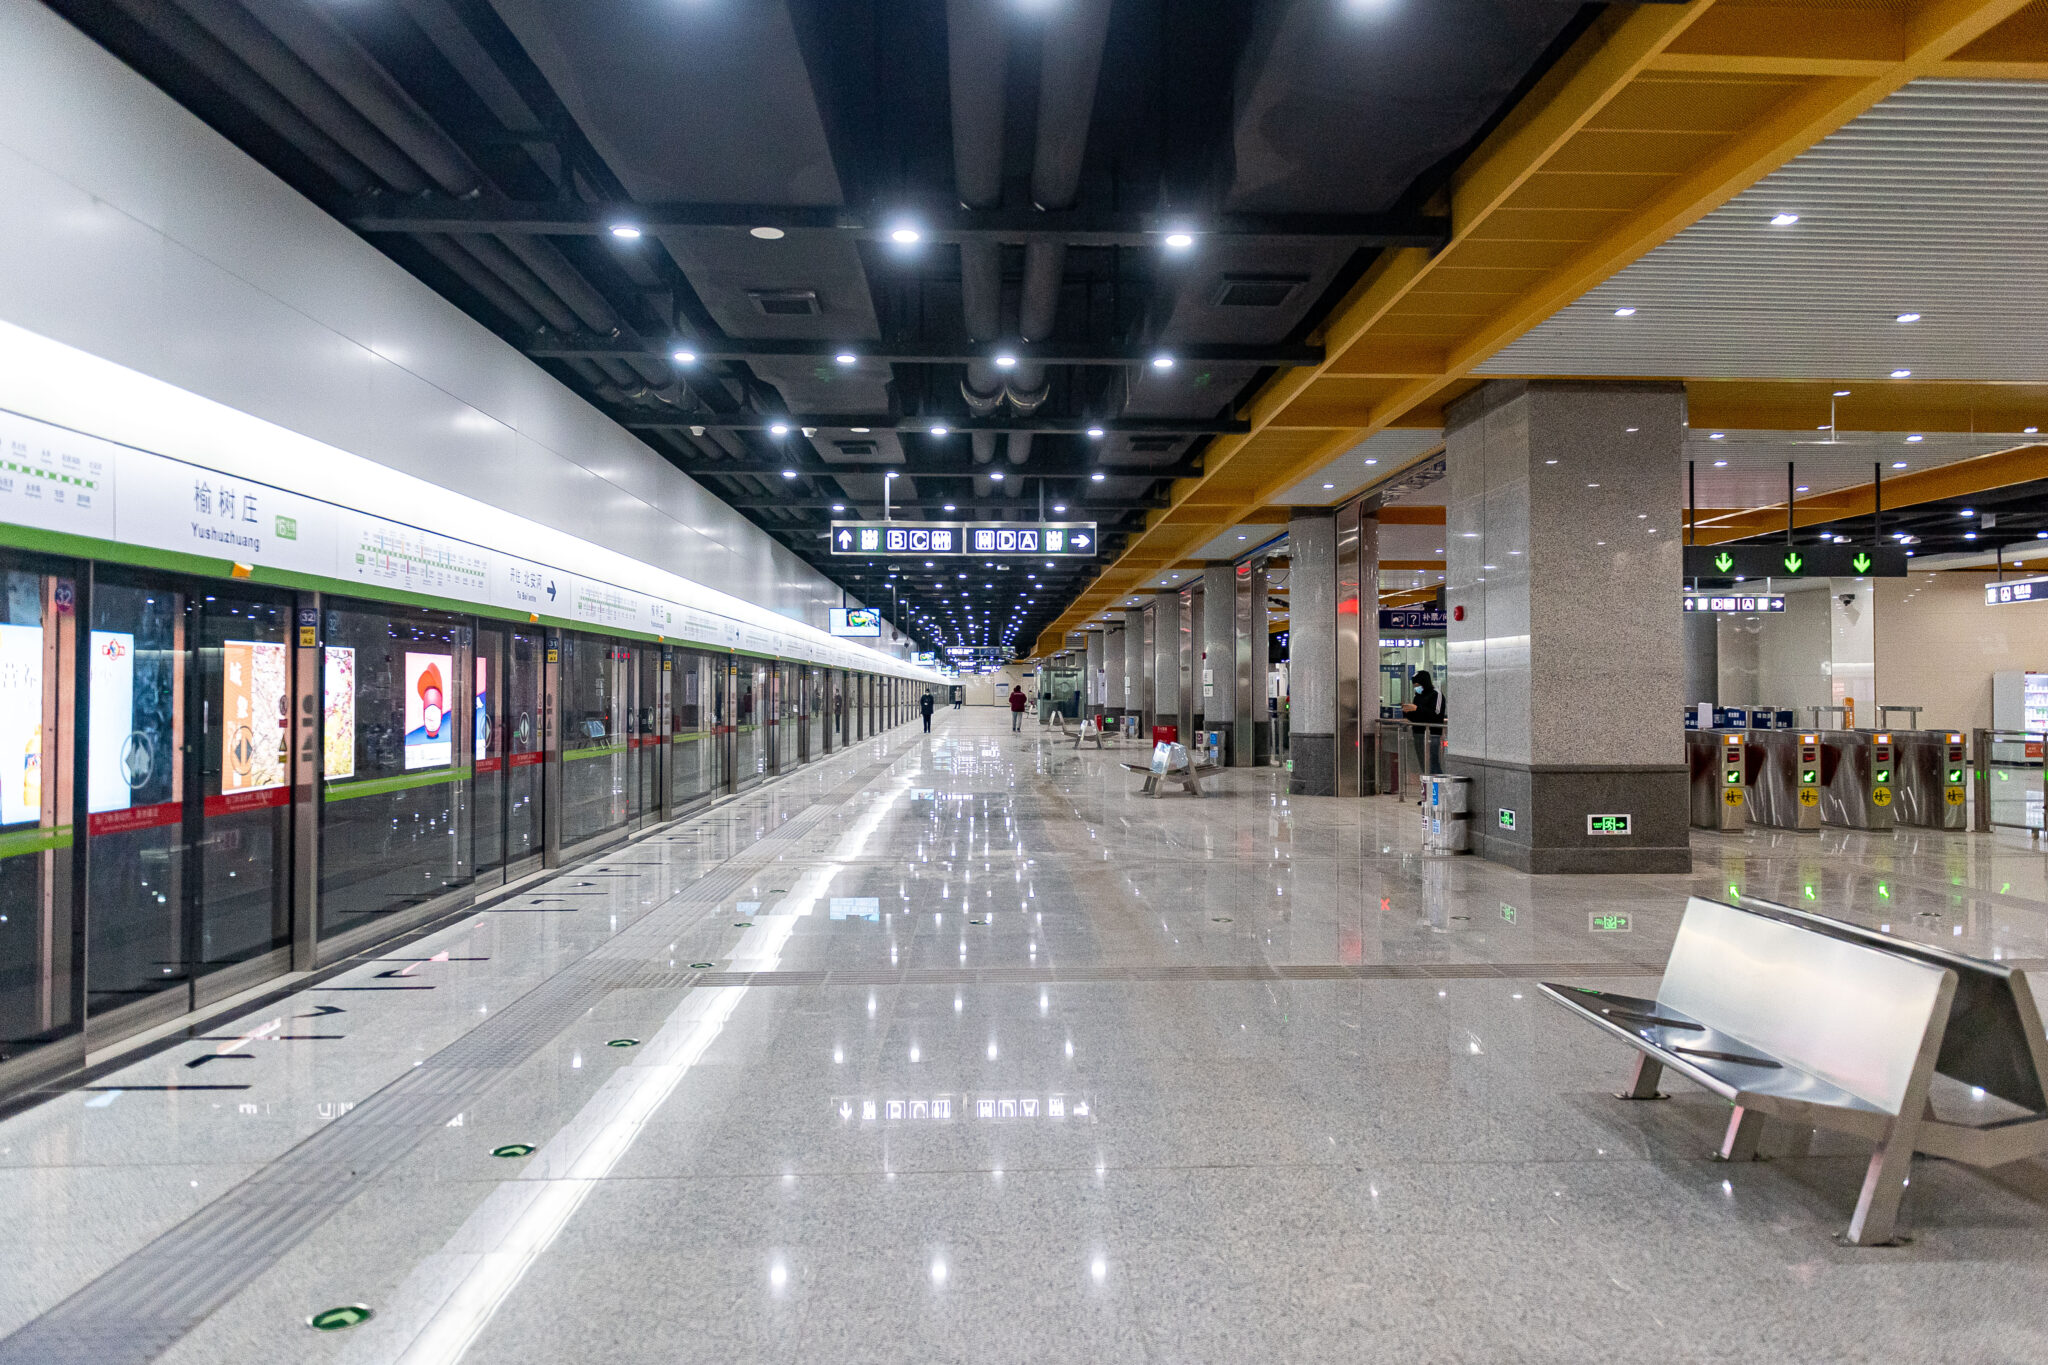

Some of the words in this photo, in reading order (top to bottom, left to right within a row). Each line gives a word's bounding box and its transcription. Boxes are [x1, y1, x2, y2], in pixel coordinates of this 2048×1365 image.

[194, 480, 258, 523] 榆树庄
[191, 521, 260, 552] Yushuzhuang
[890, 531, 904, 549] B
[912, 531, 927, 549] C
[1000, 532, 1015, 549] D
[1021, 532, 1036, 549] A
[57, 588, 72, 606] 32
[301, 613, 315, 622] 32
